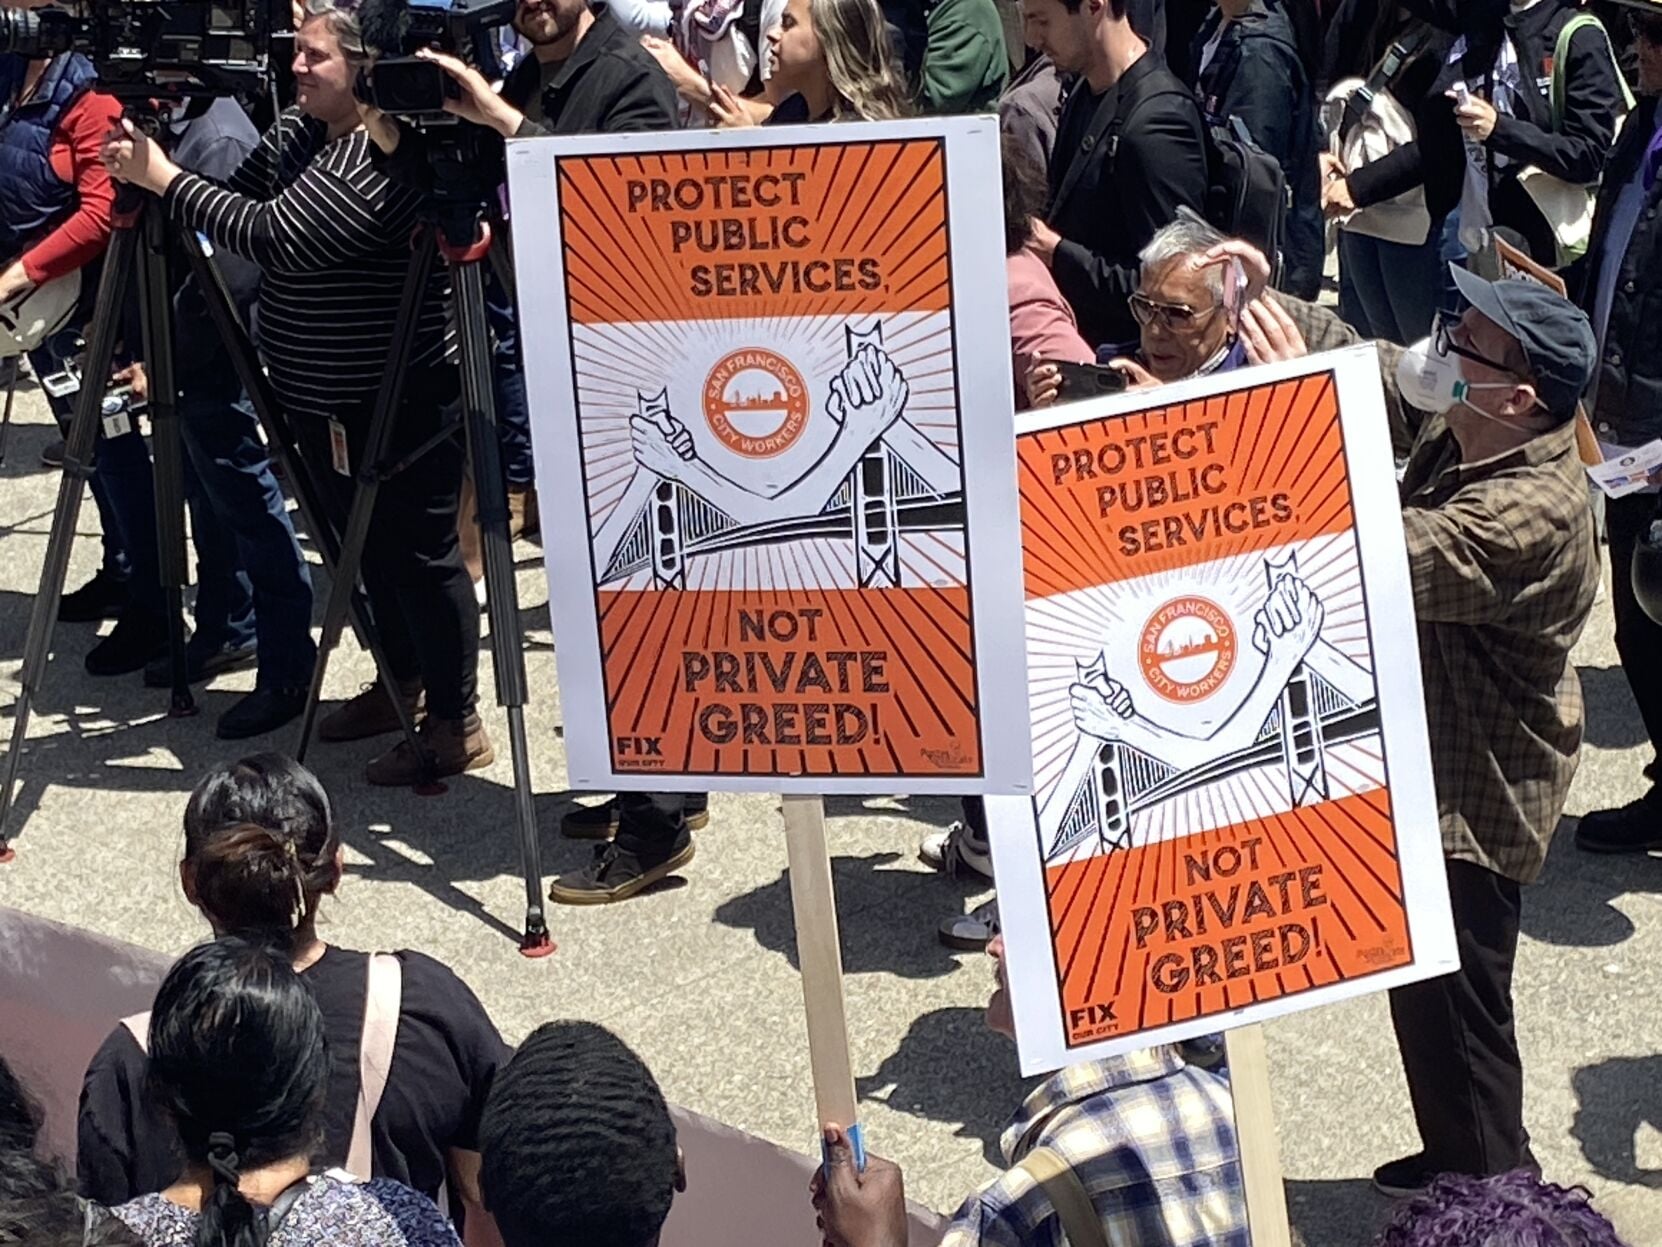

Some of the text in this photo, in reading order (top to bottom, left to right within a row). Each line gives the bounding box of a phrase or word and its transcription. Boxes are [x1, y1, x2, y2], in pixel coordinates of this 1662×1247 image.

[626, 172, 806, 213] PROTECT
[670, 215, 812, 254] PUBLIC
[708, 353, 802, 400] SAN FRANCISCO
[712, 411, 802, 452] CITY WORKERS
[1051, 422, 1218, 486] PROTECT
[1096, 462, 1228, 519] PUBLIC
[738, 608, 823, 642] NOT
[1143, 601, 1230, 653] SAN FRANCISCO
[681, 650, 890, 695] PRIVATE
[1149, 650, 1232, 698] CITY WORKERS
[617, 737, 663, 755] FIX
[699, 702, 882, 746] GREED!
[1184, 837, 1263, 887] NOT
[1131, 864, 1328, 950] PRIVATE
[1151, 917, 1323, 994] GREED!
[1070, 1000, 1118, 1030] FIX
